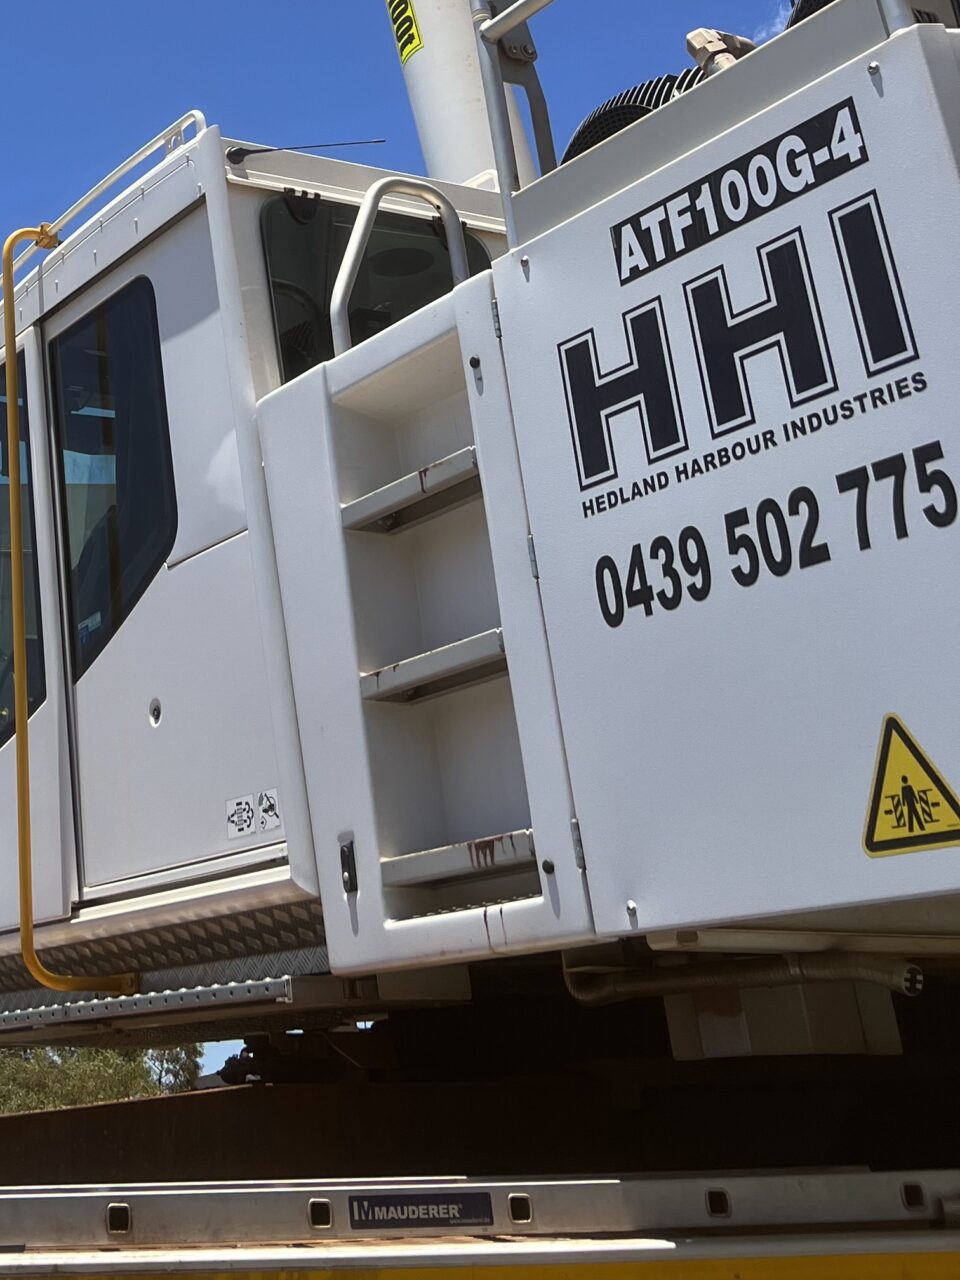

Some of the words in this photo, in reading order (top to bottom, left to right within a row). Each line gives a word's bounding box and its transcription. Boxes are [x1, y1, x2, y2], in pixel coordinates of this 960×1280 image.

[619, 106, 864, 282] ATF100G-4
[556, 188, 920, 492] HHI
[581, 470, 671, 519] HEDLAND
[674, 429, 779, 483] HARBOUR
[782, 371, 928, 443] INDUSTRIES
[594, 525, 712, 628] 0439
[723, 485, 831, 587] 502
[835, 439, 958, 551] 775
[374, 1204, 460, 1220] MAUDERER
